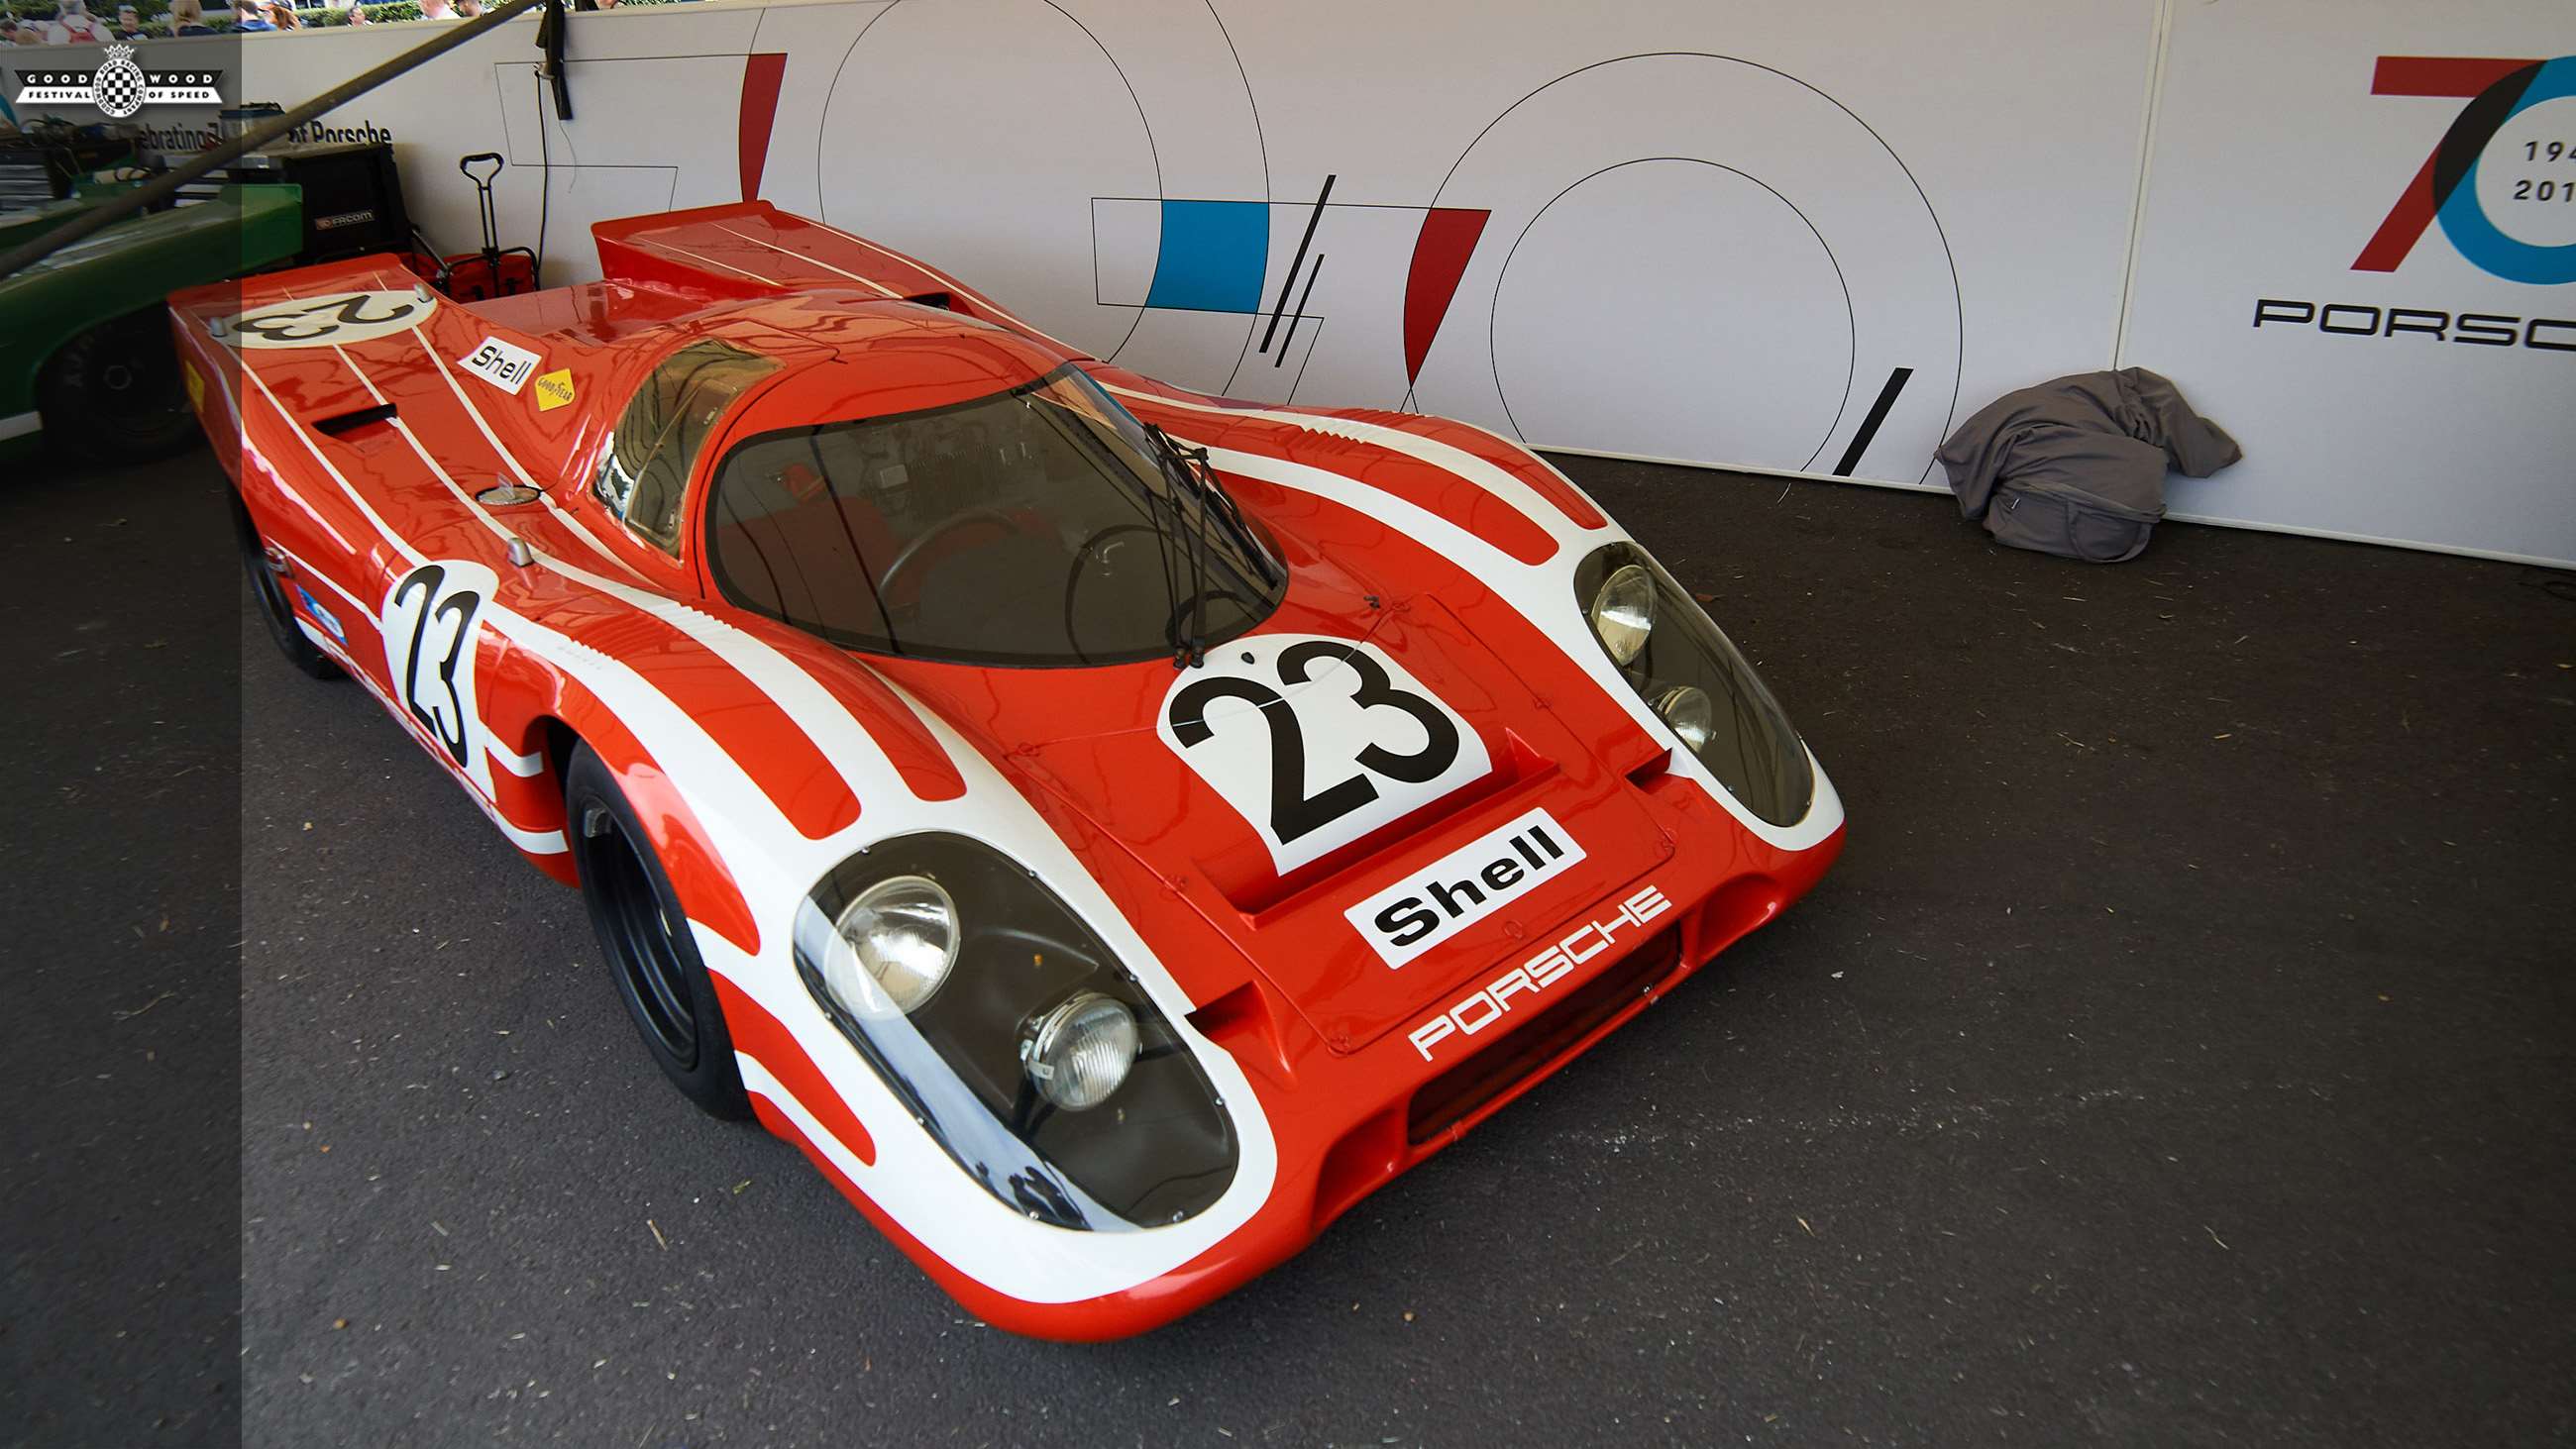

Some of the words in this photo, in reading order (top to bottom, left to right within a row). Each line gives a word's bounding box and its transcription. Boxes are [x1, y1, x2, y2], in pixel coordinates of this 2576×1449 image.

[2523, 141, 2576, 162] 19
[2513, 179, 2576, 202] 201
[233, 295, 414, 341] 23
[2253, 299, 2576, 352] PORSC
[472, 346, 532, 385] Shell
[394, 564, 481, 769] 23
[1168, 640, 1460, 846] 23
[1374, 824, 1565, 947] Shell
[1408, 884, 1672, 1063] PORSCHE
